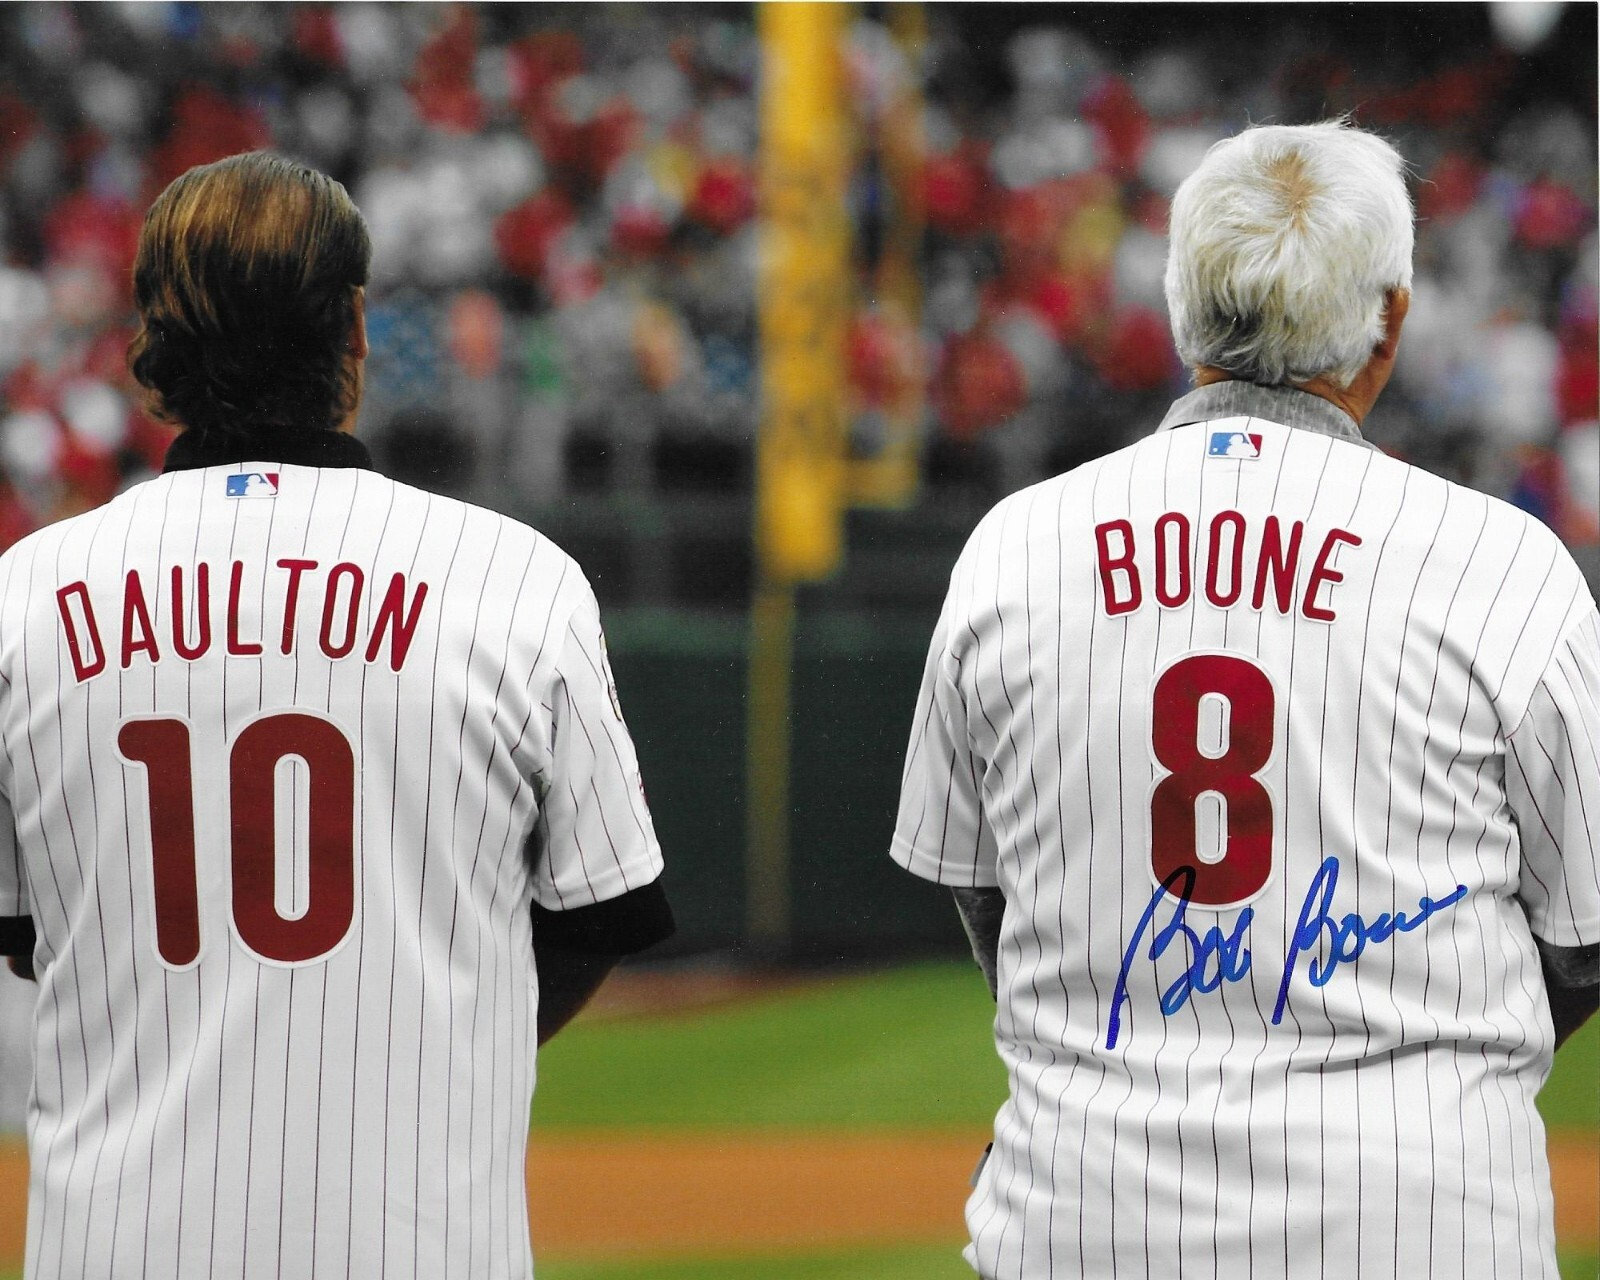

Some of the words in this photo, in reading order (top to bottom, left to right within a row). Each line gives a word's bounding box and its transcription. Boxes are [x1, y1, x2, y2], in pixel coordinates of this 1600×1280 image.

[57, 559, 428, 681] DAULTON
[1095, 510, 1362, 623] BOONE
[117, 713, 355, 966] 10
[1151, 655, 1275, 905] 8
